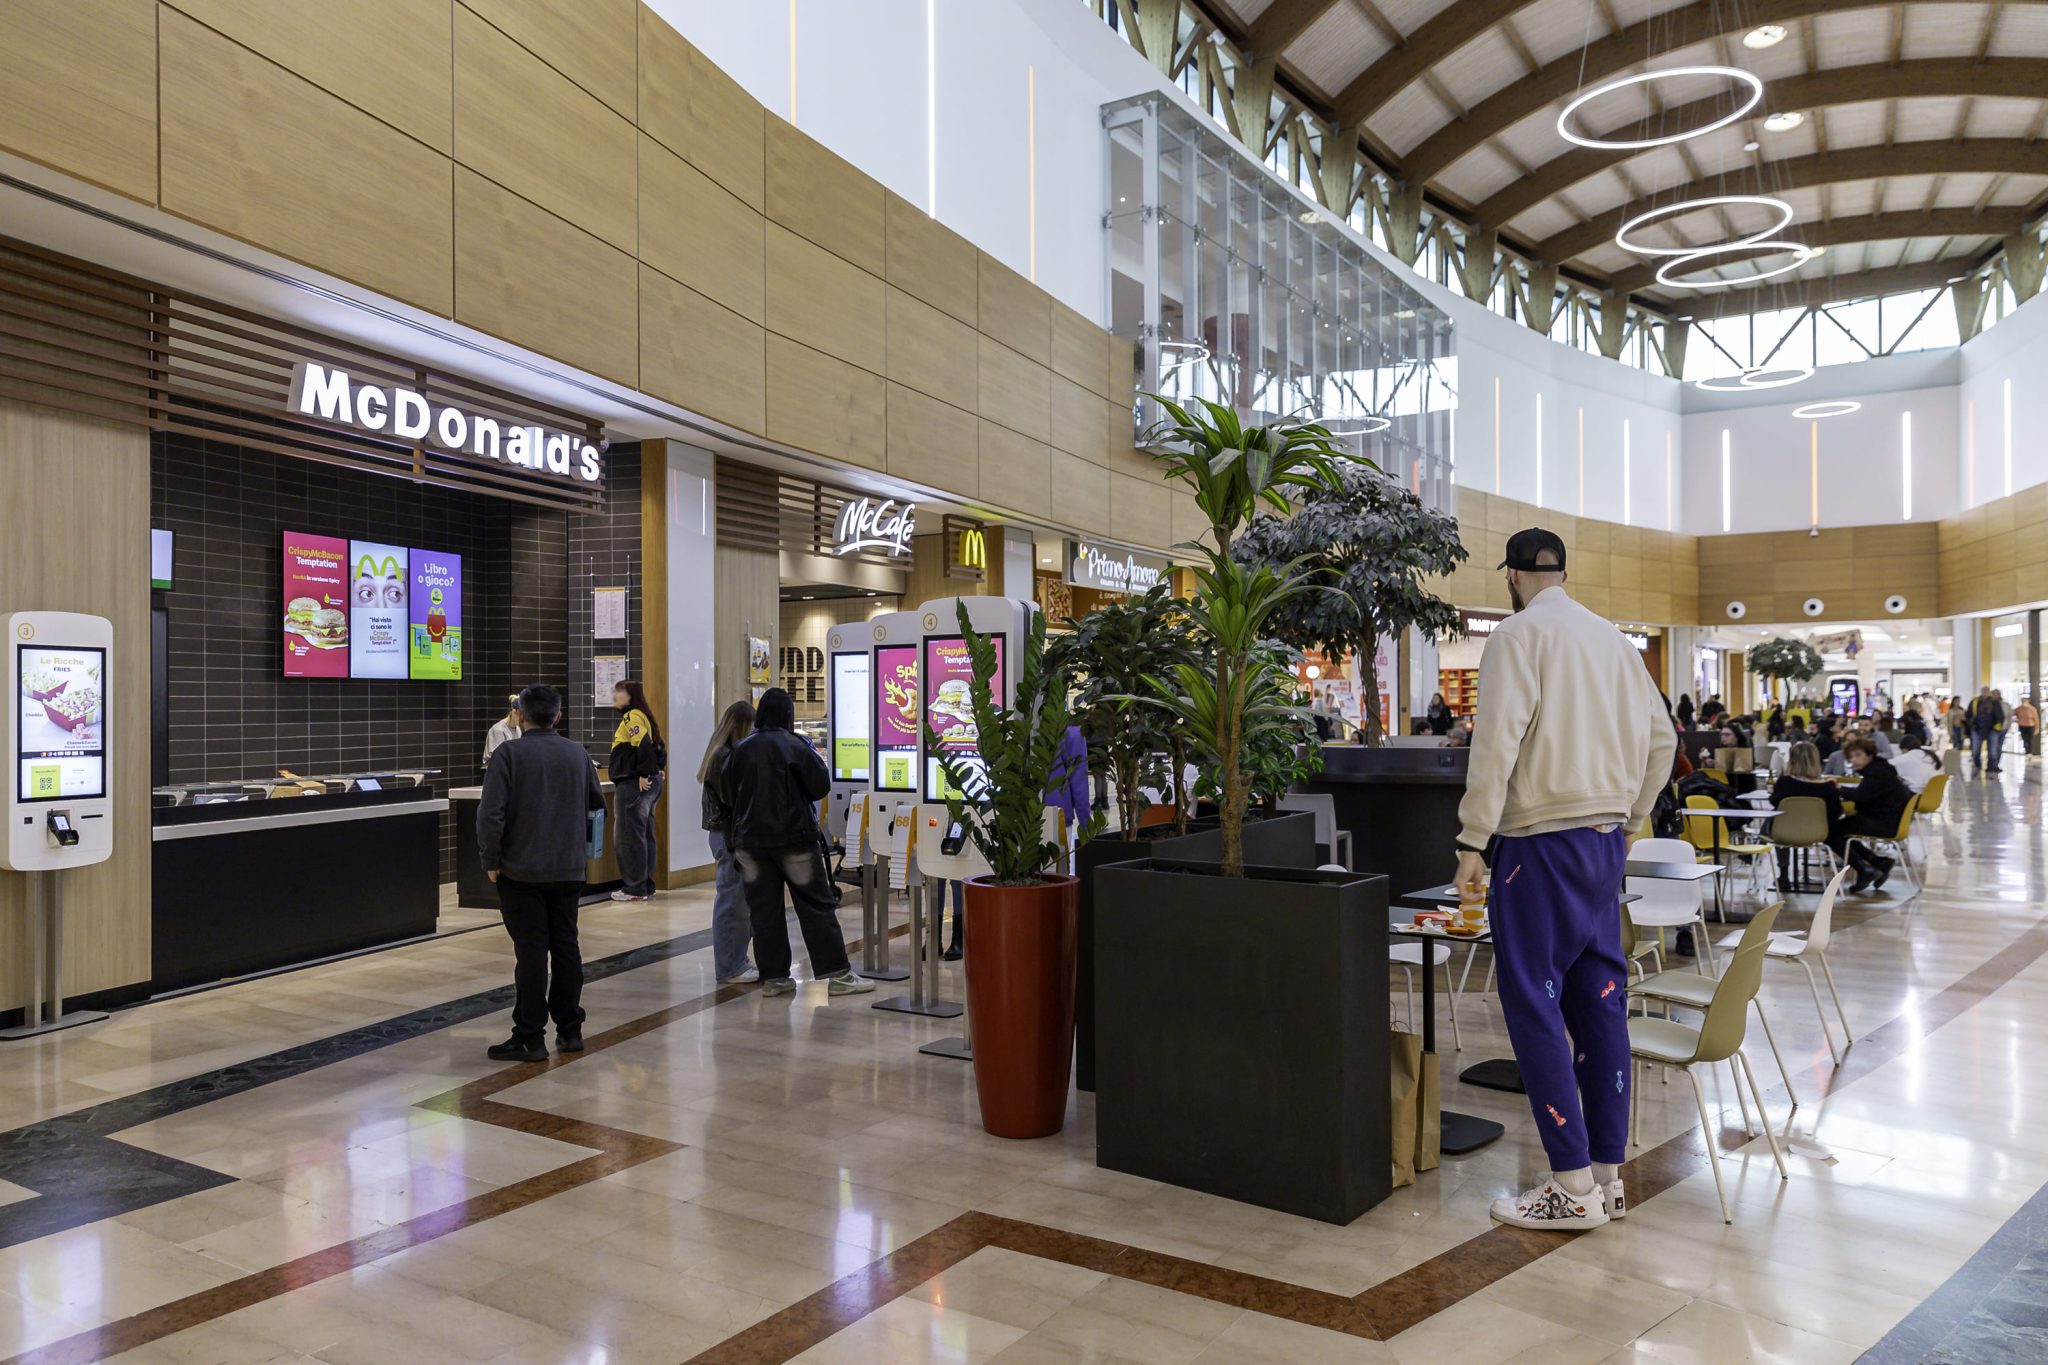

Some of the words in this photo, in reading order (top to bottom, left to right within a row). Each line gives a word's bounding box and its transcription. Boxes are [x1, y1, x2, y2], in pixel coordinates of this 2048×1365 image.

[299, 362, 600, 482] McDonald's
[840, 497, 915, 557] McCafé
[288, 546, 344, 560] CrispyMcBacon
[296, 556, 338, 568] Temptation
[1088, 547, 1123, 579] Primo
[1123, 554, 1158, 585] Amore
[424, 562, 448, 575] Libro
[418, 575, 424, 583] o
[425, 574, 454, 587] gioco?
[927, 618, 933, 626] 4
[23, 627, 29, 635] 3
[877, 629, 882, 638] 5
[834, 637, 839, 645] 6
[40, 656, 52, 665] Le
[54, 657, 84, 665] Ricche
[852, 803, 862, 813] 15
[896, 816, 909, 827] 68
